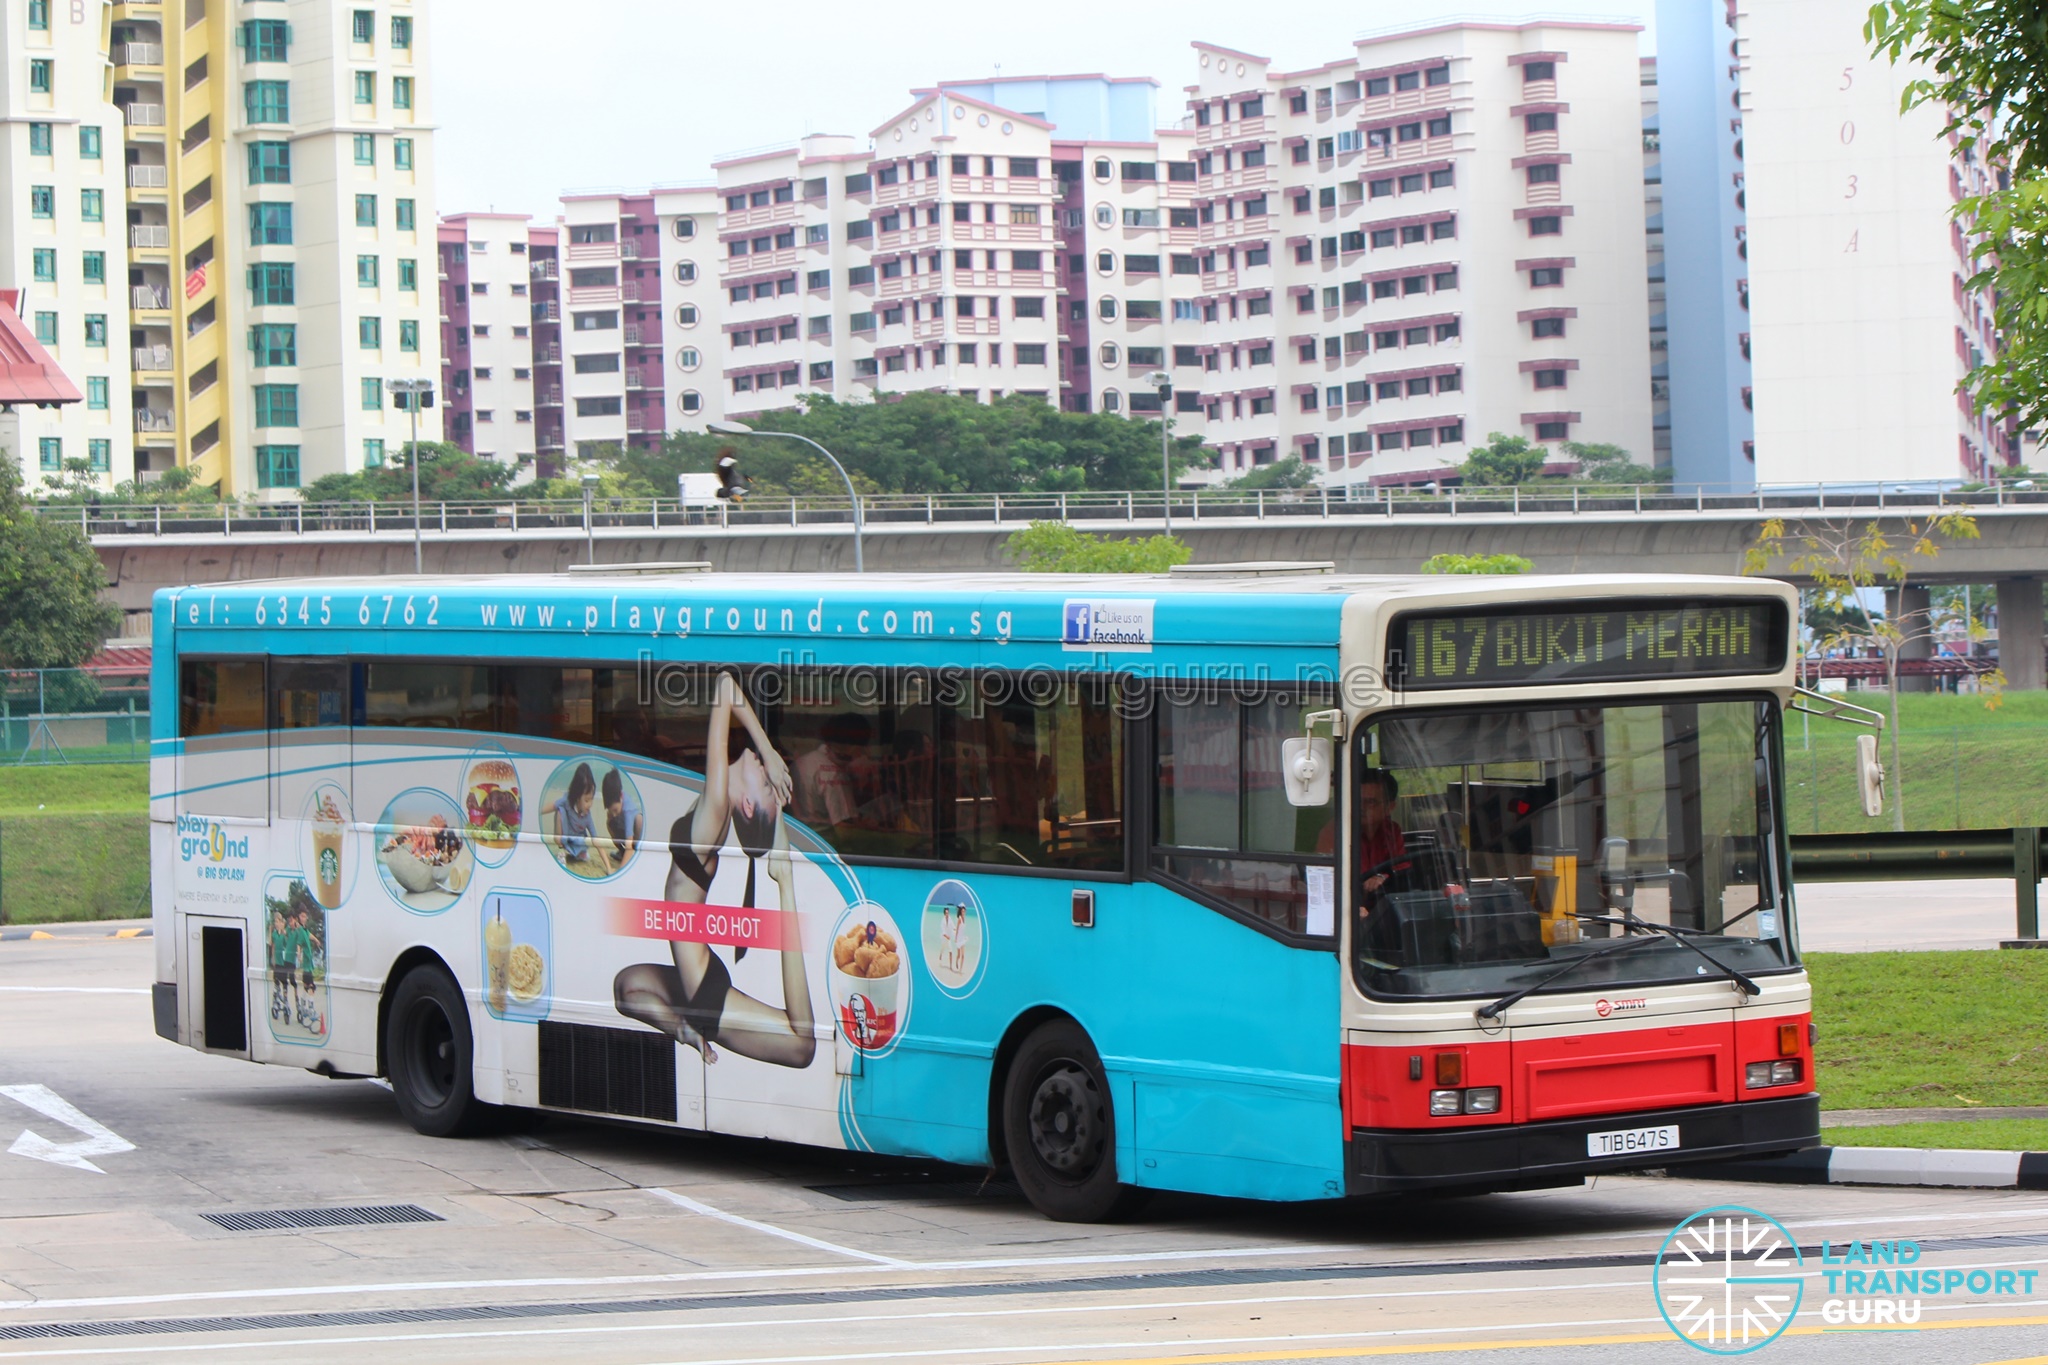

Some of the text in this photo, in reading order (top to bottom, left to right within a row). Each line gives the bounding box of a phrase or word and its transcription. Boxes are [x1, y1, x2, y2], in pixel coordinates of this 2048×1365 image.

[70, 0, 85, 24] B
[169, 594, 1012, 645] Tel: 6345 6762 www.playground.com.sg
[1107, 612, 1143, 624] Like us on
[1093, 628, 1145, 644] facebook
[1408, 609, 1750, 678] 167 BUKIT MERAH
[177, 810, 208, 836] play
[181, 823, 248, 862] ground
[205, 866, 216, 879] BIG
[219, 867, 245, 881] SPLASH
[644, 909, 662, 930] BE
[666, 911, 695, 933] HOT
[706, 914, 727, 936] GO
[731, 916, 761, 938] HOT
[1613, 998, 1647, 1011] SMRT
[1600, 1130, 1669, 1152] TIB647S
